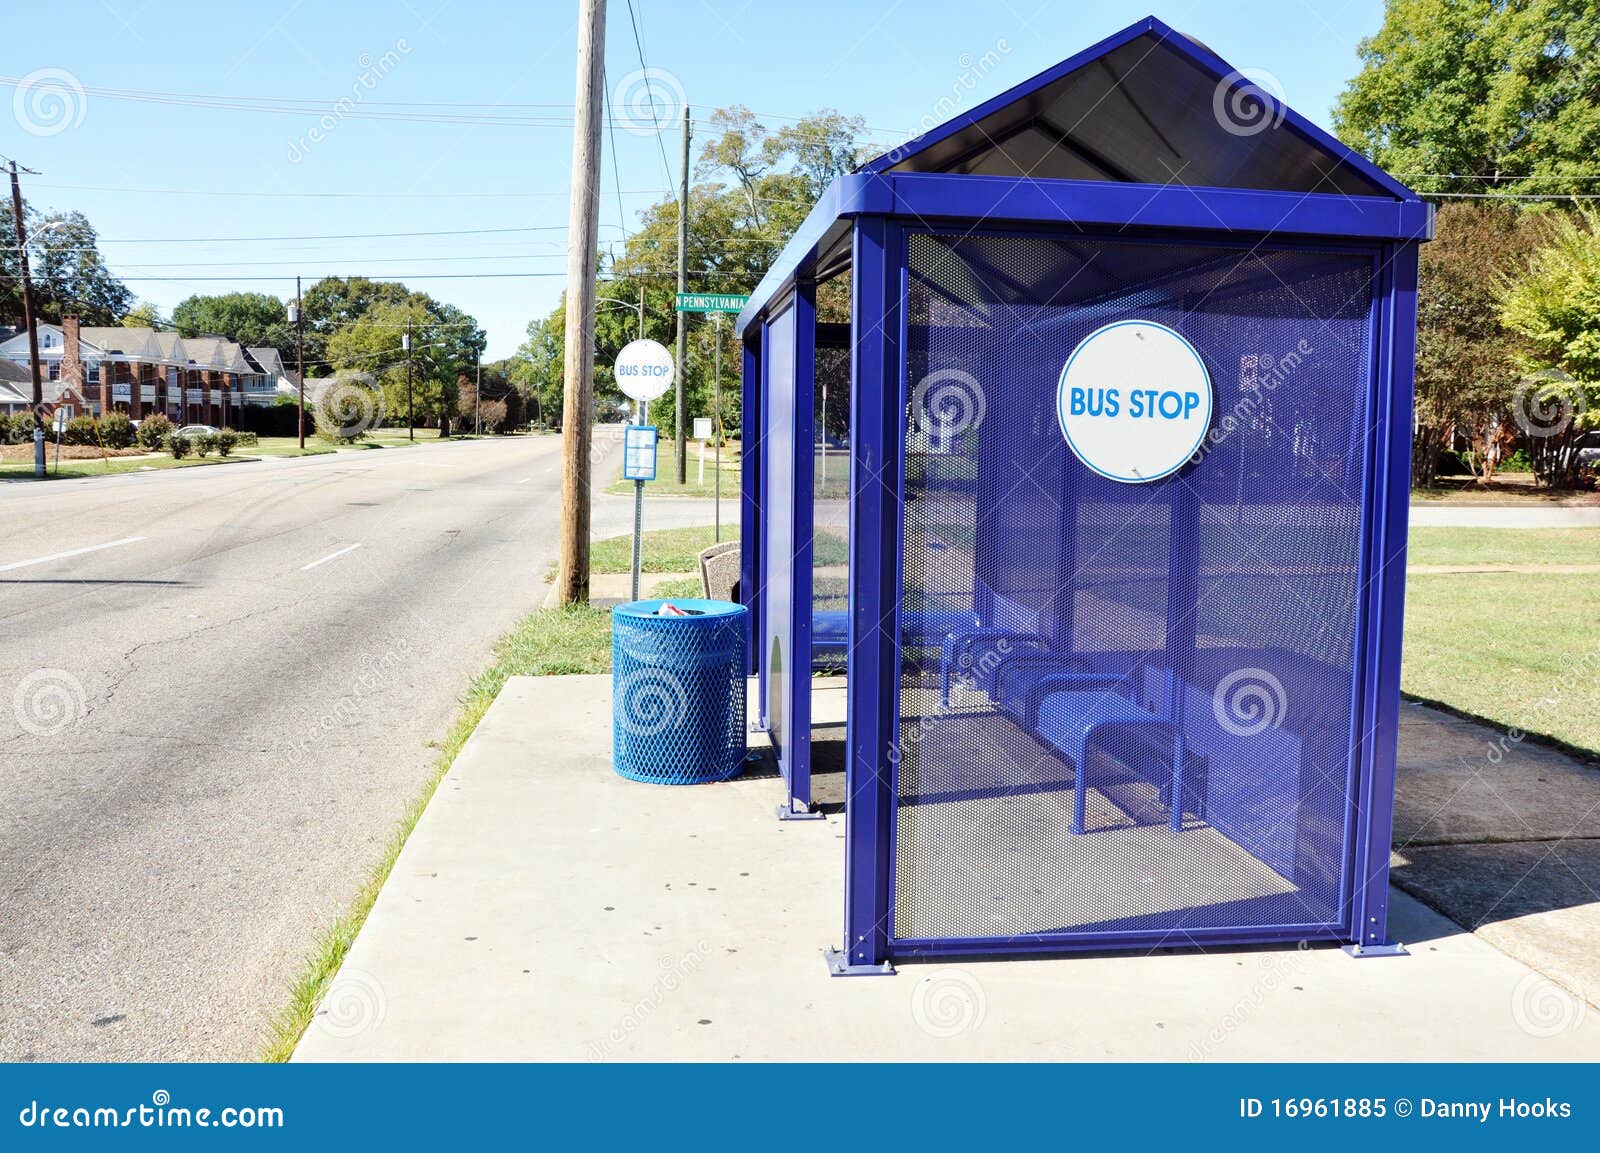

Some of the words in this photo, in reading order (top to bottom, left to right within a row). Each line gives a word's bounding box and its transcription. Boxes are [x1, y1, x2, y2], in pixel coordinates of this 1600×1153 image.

[676, 295, 682, 307] N
[683, 296, 745, 309] PENNSYLVANIA
[619, 364, 639, 376] BUS
[641, 365, 670, 376] STOP
[1070, 387, 1120, 417] BUS
[1129, 389, 1200, 419] STOP
